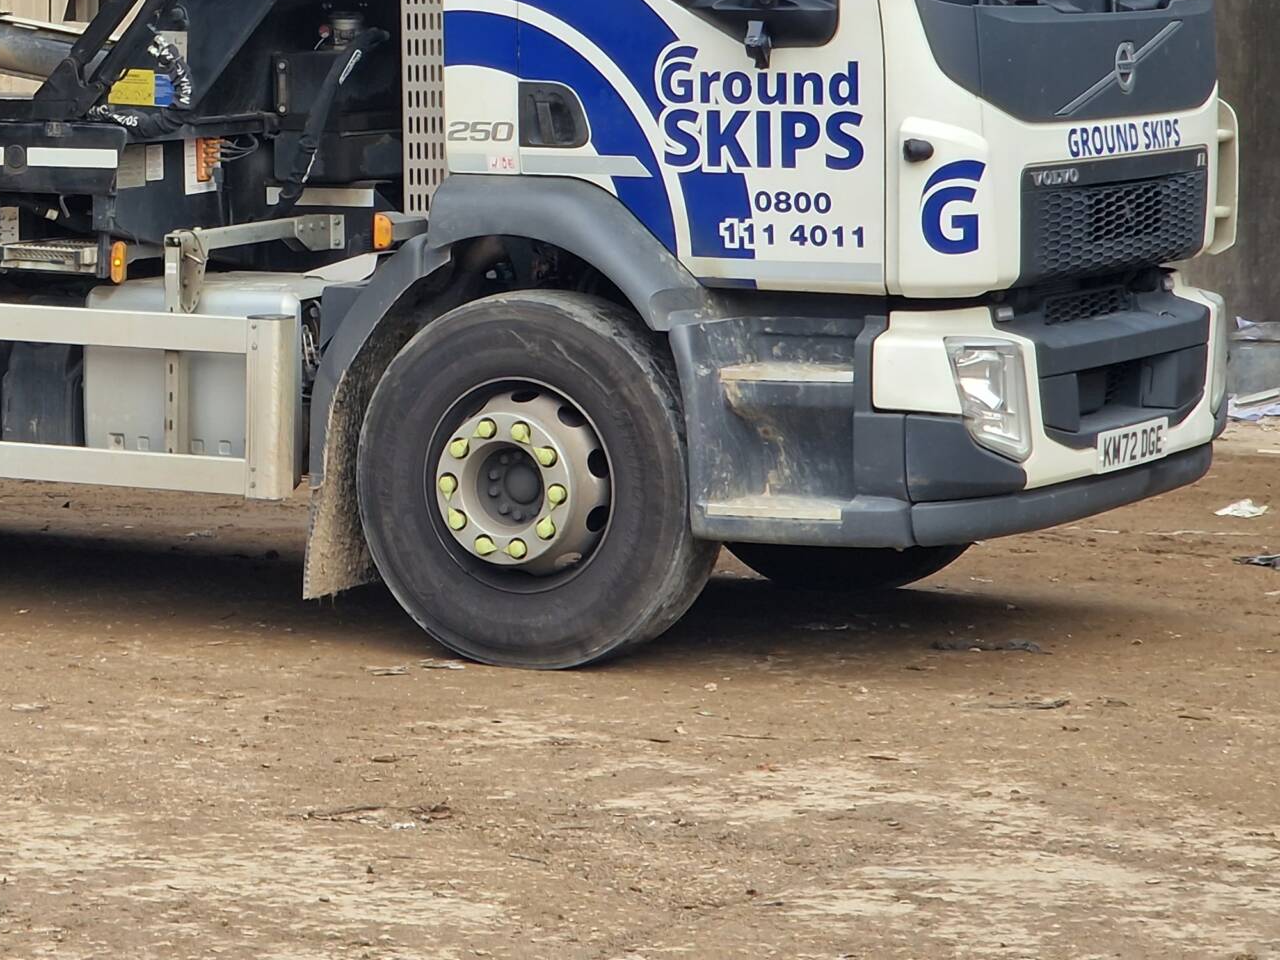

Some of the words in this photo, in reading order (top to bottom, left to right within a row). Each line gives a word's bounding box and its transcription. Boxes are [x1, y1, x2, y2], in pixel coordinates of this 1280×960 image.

[660, 45, 860, 106] Ground
[447, 121, 515, 142] 250
[663, 108, 866, 171] SKIPS
[1068, 122, 1140, 159] GROUND
[1142, 117, 1182, 153] SKIPS
[1031, 168, 1080, 186] VOLVO
[753, 190, 833, 215] 0800
[920, 159, 987, 255] G
[722, 219, 775, 247] 111
[788, 223, 865, 249] 4011
[1102, 430, 1139, 469] KM72
[1140, 424, 1163, 458] DGE
